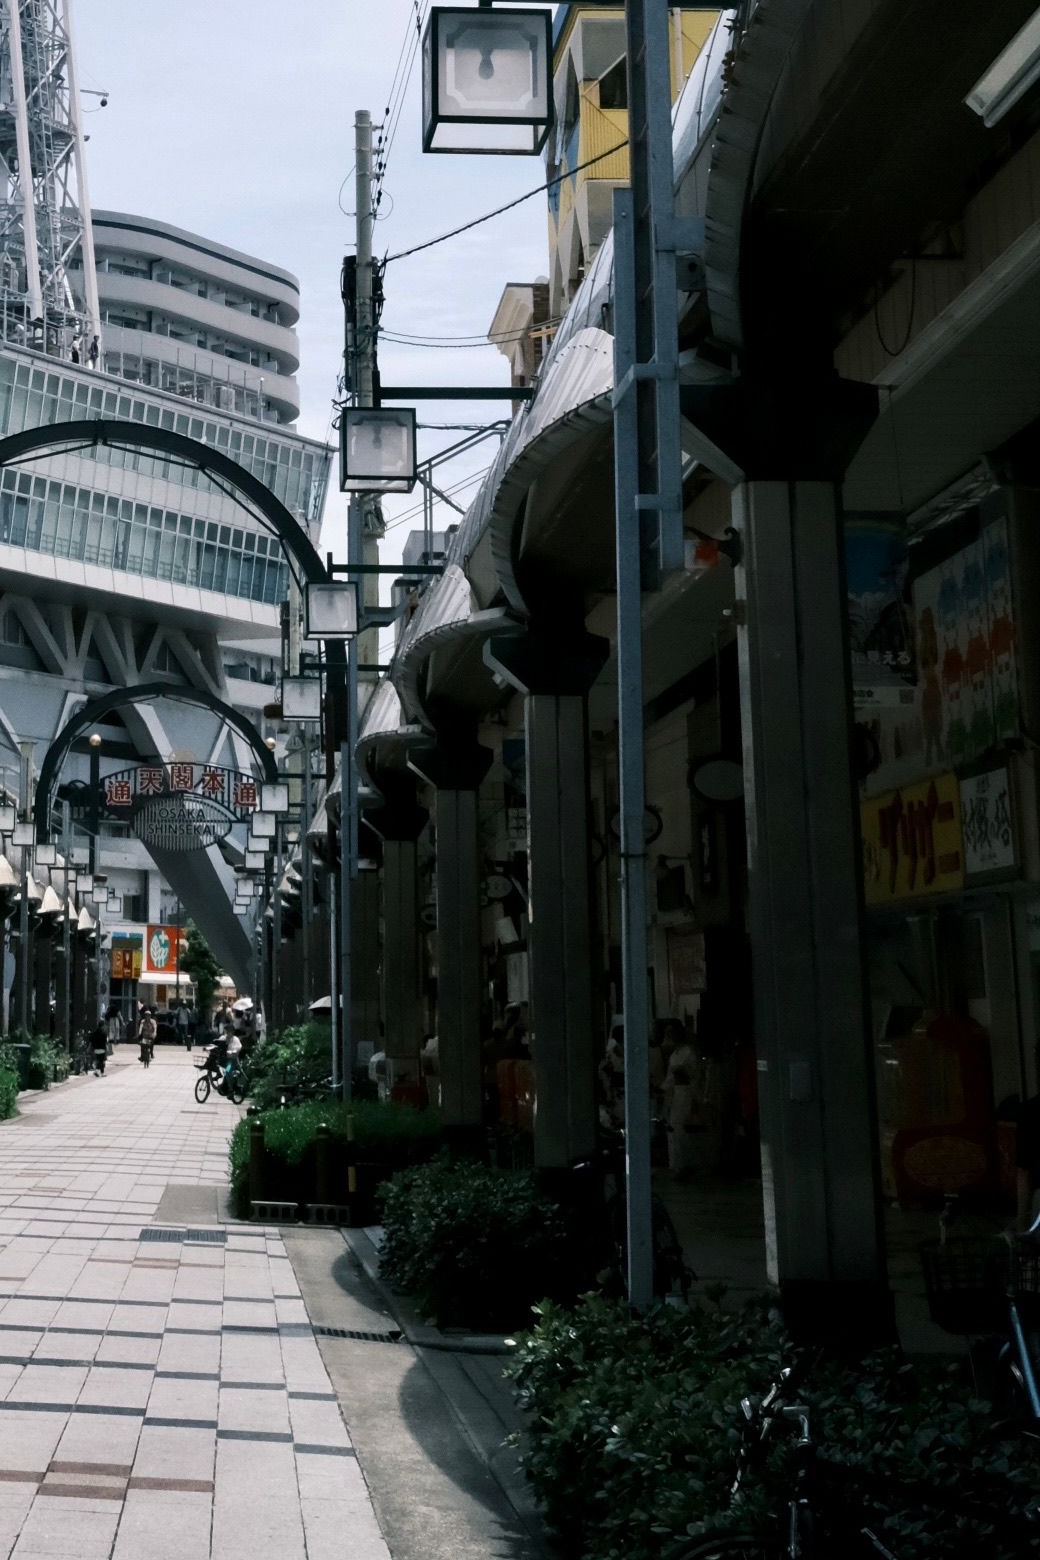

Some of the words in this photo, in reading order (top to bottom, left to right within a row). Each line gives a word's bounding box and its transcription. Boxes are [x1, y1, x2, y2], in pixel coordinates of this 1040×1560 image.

[106, 764, 257, 808] 通天閣本通
[158, 807, 206, 819] OSAKA
[147, 823, 217, 836] SHINSEKAI
